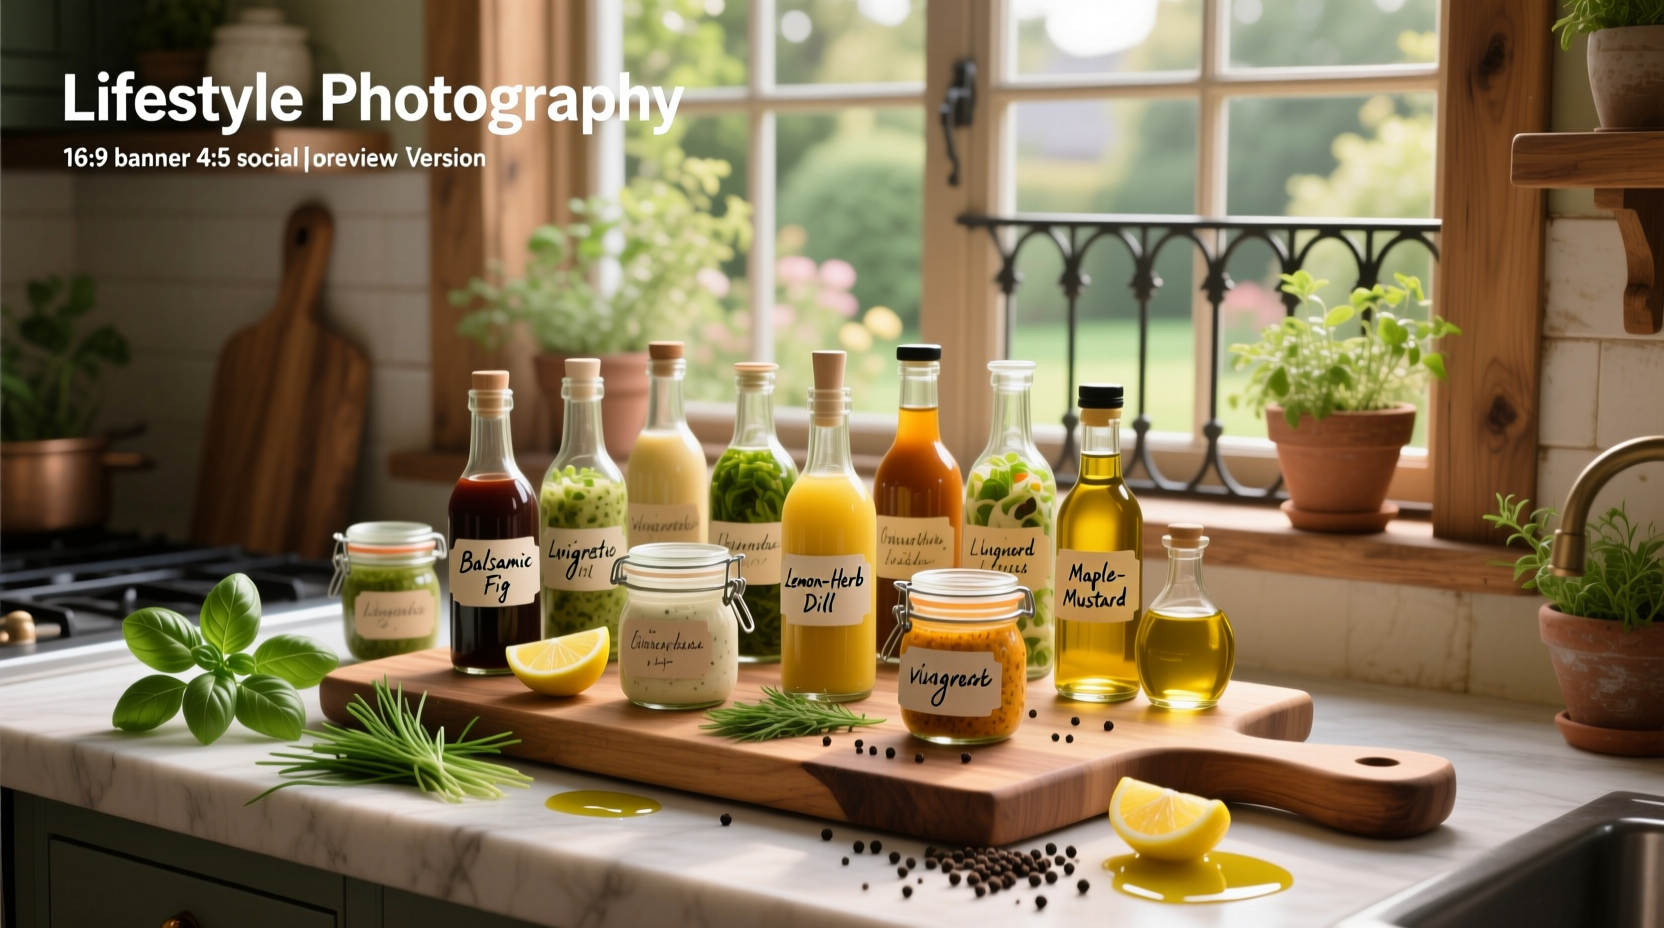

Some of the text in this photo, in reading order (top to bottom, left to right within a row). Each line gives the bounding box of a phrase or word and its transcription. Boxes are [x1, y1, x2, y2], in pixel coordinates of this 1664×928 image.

[459, 548, 533, 573] Balsamic
[784, 565, 864, 589] Lemon-Herb
[1068, 561, 1126, 591] Maple-
[484, 574, 511, 604] Fig
[1062, 586, 1127, 608] Mustard
[803, 592, 836, 613] Dill
